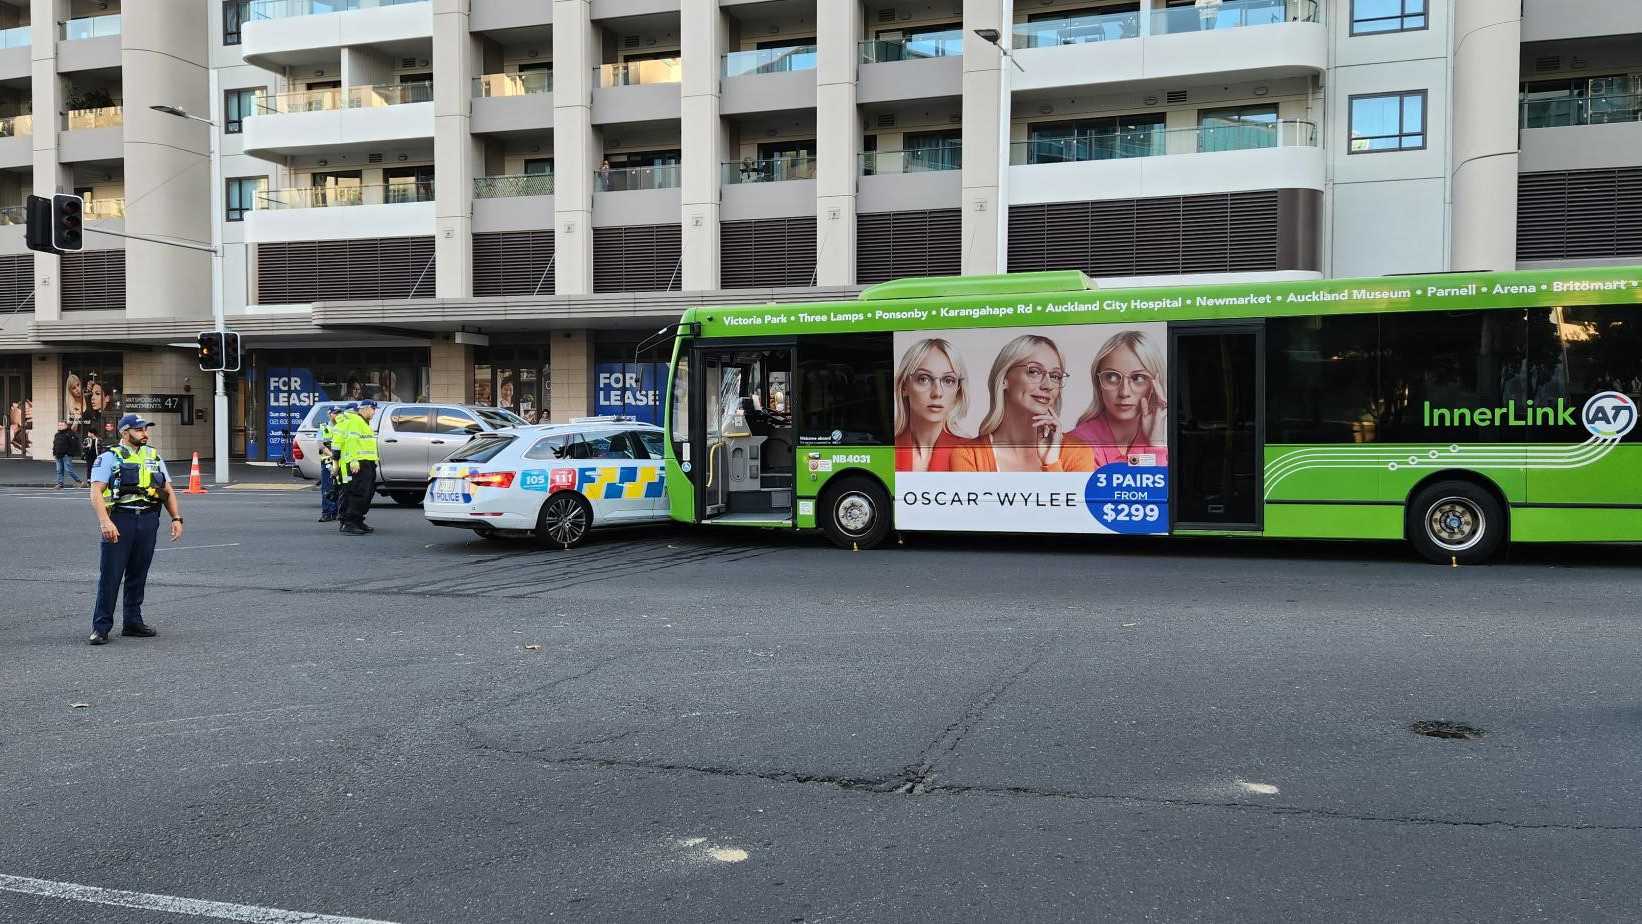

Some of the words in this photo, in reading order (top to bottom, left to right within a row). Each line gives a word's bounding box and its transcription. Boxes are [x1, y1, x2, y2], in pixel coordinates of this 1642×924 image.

[723, 315, 762, 326] Victoria
[764, 313, 787, 325] Park
[798, 313, 828, 324] Three
[830, 312, 864, 323] Lamps
[875, 309, 928, 321] Ponsonby
[940, 305, 1014, 318] Karangahape
[1017, 304, 1032, 314] Rd
[1045, 301, 1099, 313] Auckland
[1103, 300, 1128, 312] City
[1130, 297, 1182, 311] Hospital
[1196, 293, 1272, 307] Newmarket
[1286, 290, 1348, 303] Auckland
[1352, 289, 1411, 300] Museum
[1427, 284, 1476, 297] Parnell
[1492, 283, 1537, 295] Arena
[269, 377, 301, 391] FOR
[600, 373, 637, 388] FOR
[164, 397, 178, 409] 47
[269, 393, 319, 406] LEASE
[600, 390, 660, 406] LEASE
[1424, 397, 1576, 426] InnerLink
[1587, 405, 1632, 425] AT
[832, 455, 871, 463] NB4031
[526, 475, 545, 485] 105
[554, 474, 573, 483] 111
[1096, 473, 1107, 487] 3
[1112, 474, 1165, 487] PAIRS
[436, 492, 460, 502] POLICE
[903, 491, 979, 506] OSCAR
[996, 492, 1077, 507] WYLEE
[1114, 491, 1148, 500] FROM
[1102, 503, 1160, 522] $299
